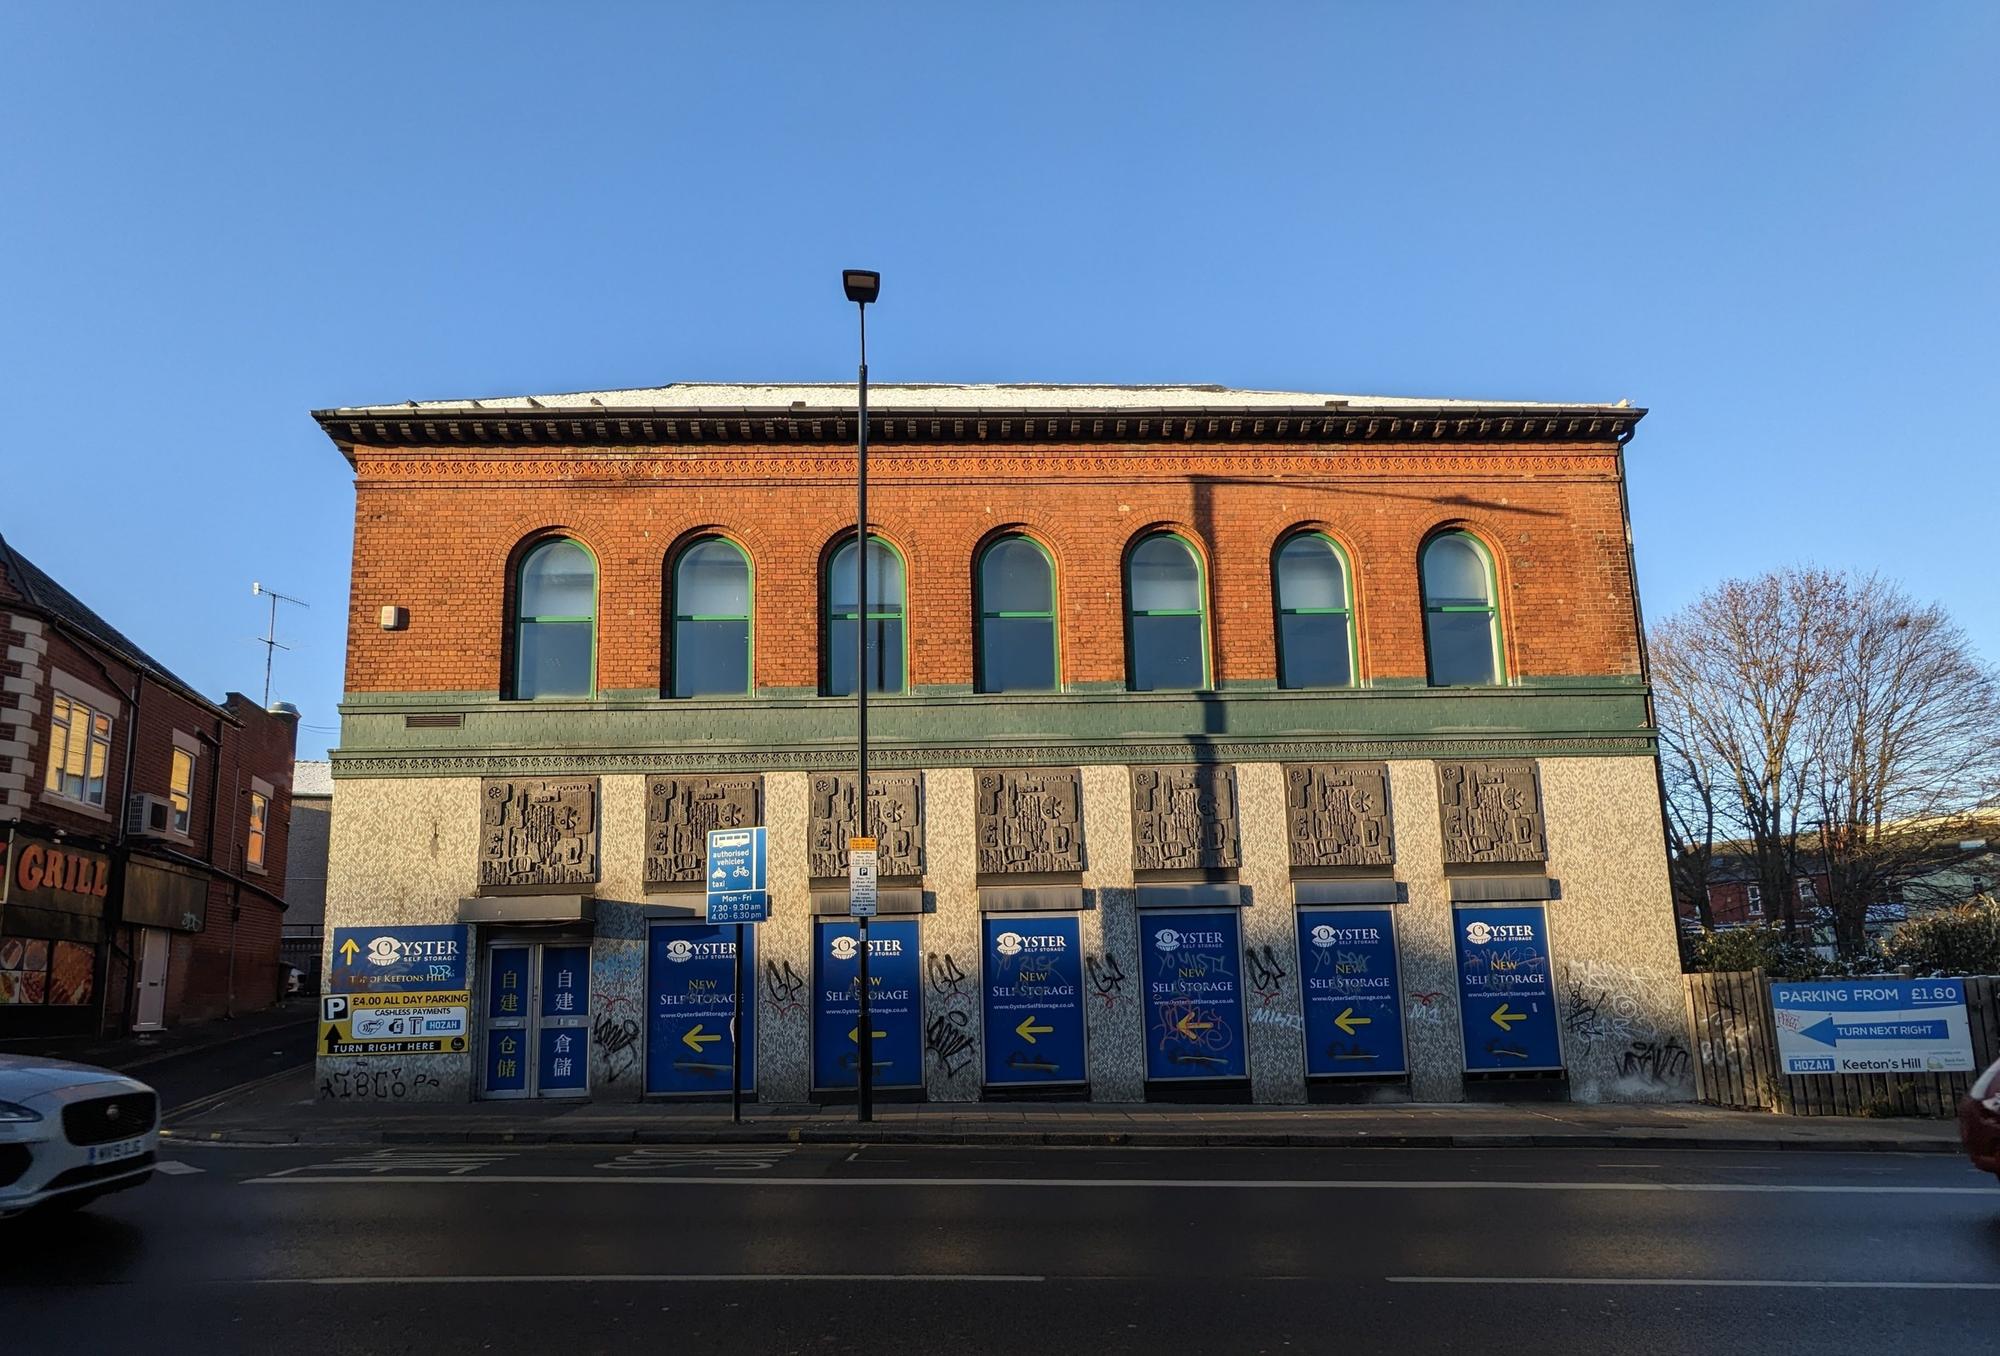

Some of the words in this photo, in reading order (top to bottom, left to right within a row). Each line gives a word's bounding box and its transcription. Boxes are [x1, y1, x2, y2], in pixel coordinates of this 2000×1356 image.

[713, 849, 750, 858] authorised
[717, 858, 745, 866] vehicles
[18, 843, 108, 897] GRILL
[1317, 928, 1381, 940] OYSTER
[1472, 925, 1535, 936] OYSTER
[1003, 935, 1067, 948] OYSTER
[1161, 932, 1224, 944] OYSTER
[376, 940, 460, 957] OYSTER
[673, 942, 737, 955] OYSTER
[838, 940, 903, 952] OSTER
[1335, 964, 1363, 974] NEW
[1490, 960, 1518, 970] NEW
[384, 974, 424, 983] KEETONS
[1019, 971, 1048, 982] NEW
[1178, 968, 1206, 978] NEW
[688, 979, 718, 990] NEW
[853, 976, 882, 986] NW
[1310, 978, 1334, 989] SELF
[1337, 977, 1390, 988] STORAGE
[1493, 974, 1545, 985] STORAGE
[1020, 985, 1075, 996] STORAGE
[1180, 981, 1233, 992] STORAGE
[660, 994, 686, 1005] SELF
[688, 993, 744, 1004] STORAG
[826, 990, 851, 1001] SELF
[855, 990, 909, 1001] SORAGE
[1779, 989, 1848, 1003] PARKING
[1853, 988, 1899, 1001] FROM
[1911, 987, 1957, 1000] £1.60
[327, 998, 346, 1019] P
[353, 997, 381, 1006] £4.00
[384, 996, 400, 1005] ALL
[403, 995, 423, 1004] DAY
[427, 994, 469, 1003] PARKING
[412, 1007, 451, 1015] PAYMENTS
[826, 1007, 908, 1015] www.OysterfStorage.co.uk
[660, 1010, 744, 1019] www.OysterSelfStorage.co
[429, 1021, 457, 1029] HOZAH
[1837, 1027, 1868, 1036] TURN
[1870, 1026, 1898, 1035] NEXT
[1900, 1025, 1933, 1035] RIGHT
[333, 1044, 364, 1053] TURN
[368, 1043, 402, 1052] RIGHT
[407, 1042, 435, 1050] HERE
[1793, 1060, 1830, 1070] HOZAH
[1842, 1059, 1898, 1070] Keeton's
[1901, 1058, 1921, 1069] Hill
